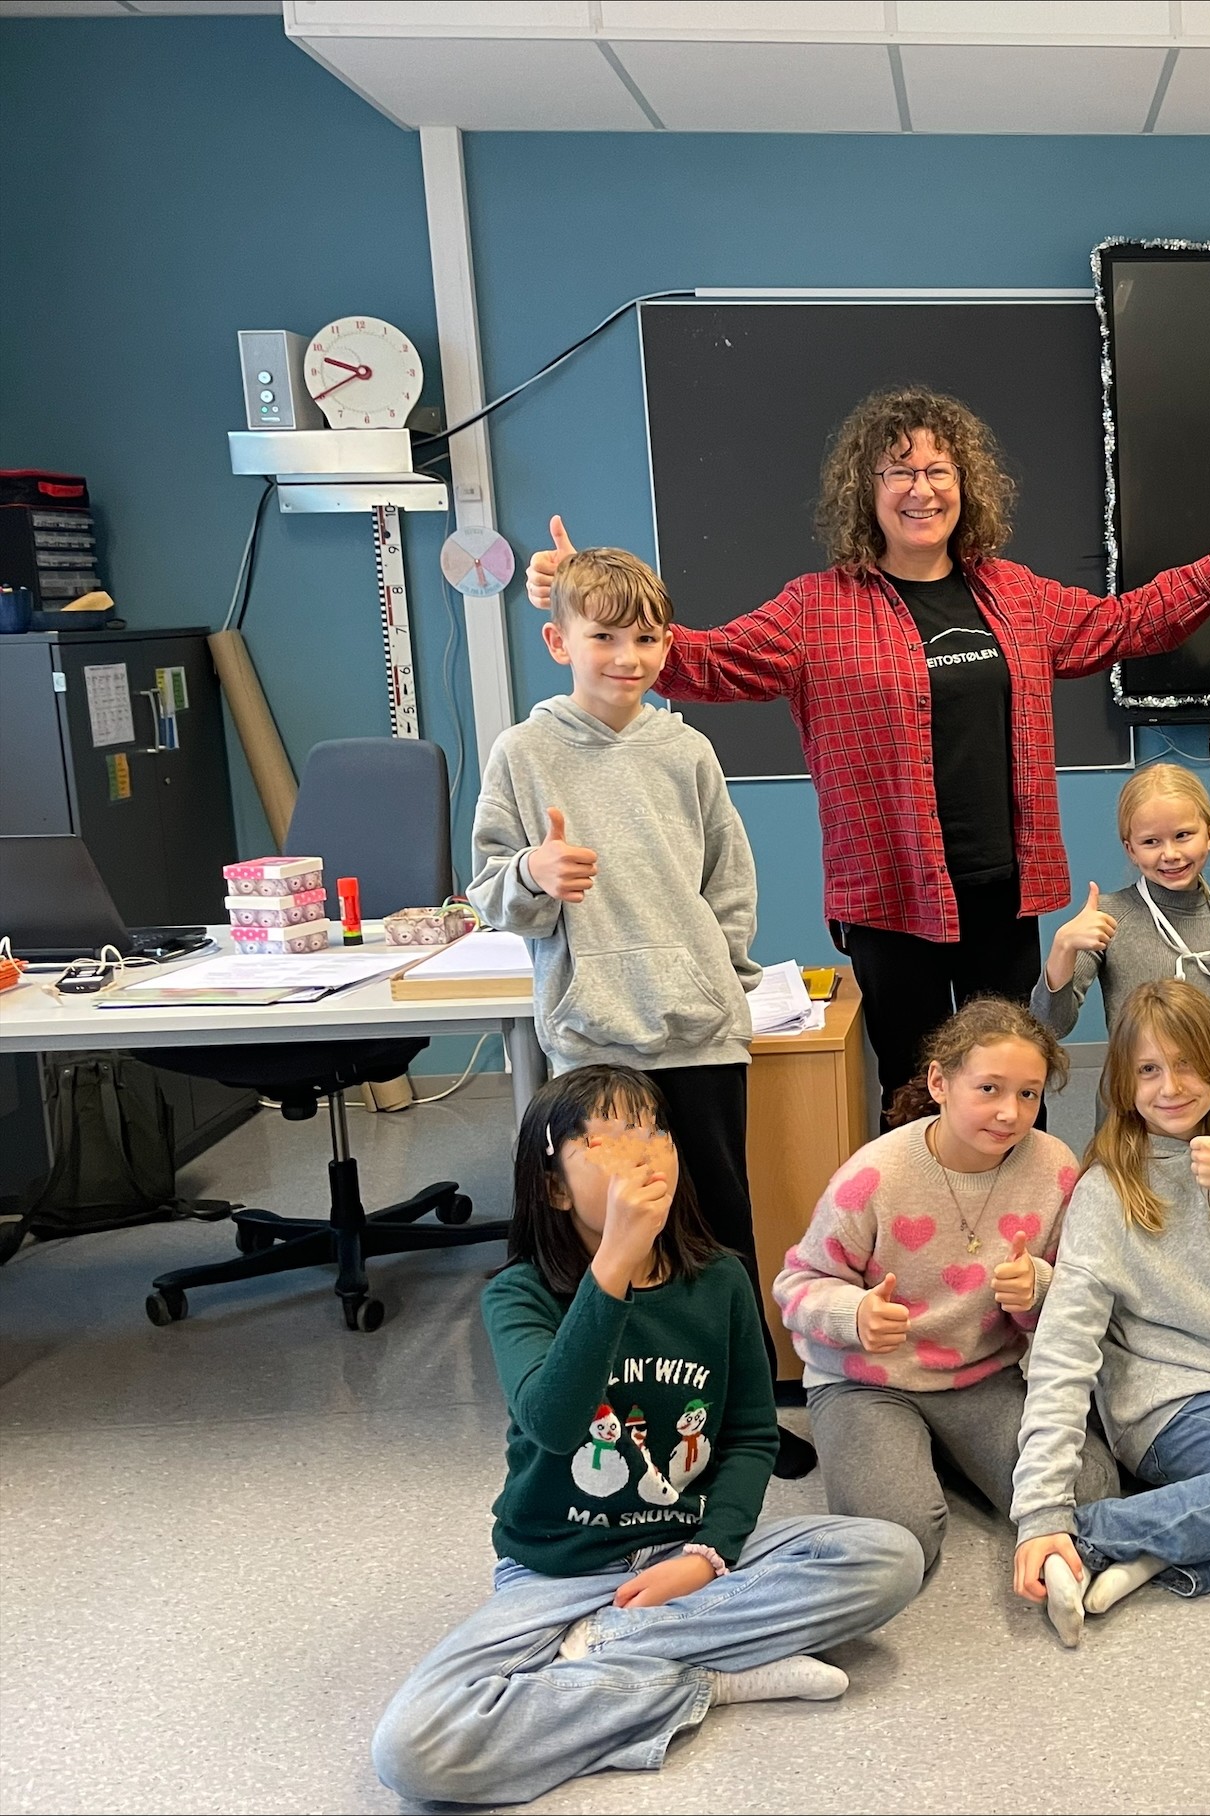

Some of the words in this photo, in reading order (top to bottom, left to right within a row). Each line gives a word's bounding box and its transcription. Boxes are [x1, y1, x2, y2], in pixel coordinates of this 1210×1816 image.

[356, 320, 366, 329] 12
[331, 325, 340, 334] 11
[313, 343, 323, 352] 10
[402, 344, 409, 353] 2
[311, 367, 317, 377] 9
[409, 368, 416, 378] 3
[404, 392, 410, 401] 4
[337, 409, 343, 418] 7
[389, 409, 396, 418] 5
[364, 415, 370, 424] 6
[384, 504, 397, 517] 10
[388, 546, 400, 554] 9
[391, 586, 404, 595] 8
[395, 627, 407, 635] 7
[926, 648, 999, 669] EITOSTØLEN
[399, 666, 411, 675] 6
[403, 706, 415, 715] 5
[655, 1357, 711, 1390] WITH
[567, 1506, 611, 1528] MA
